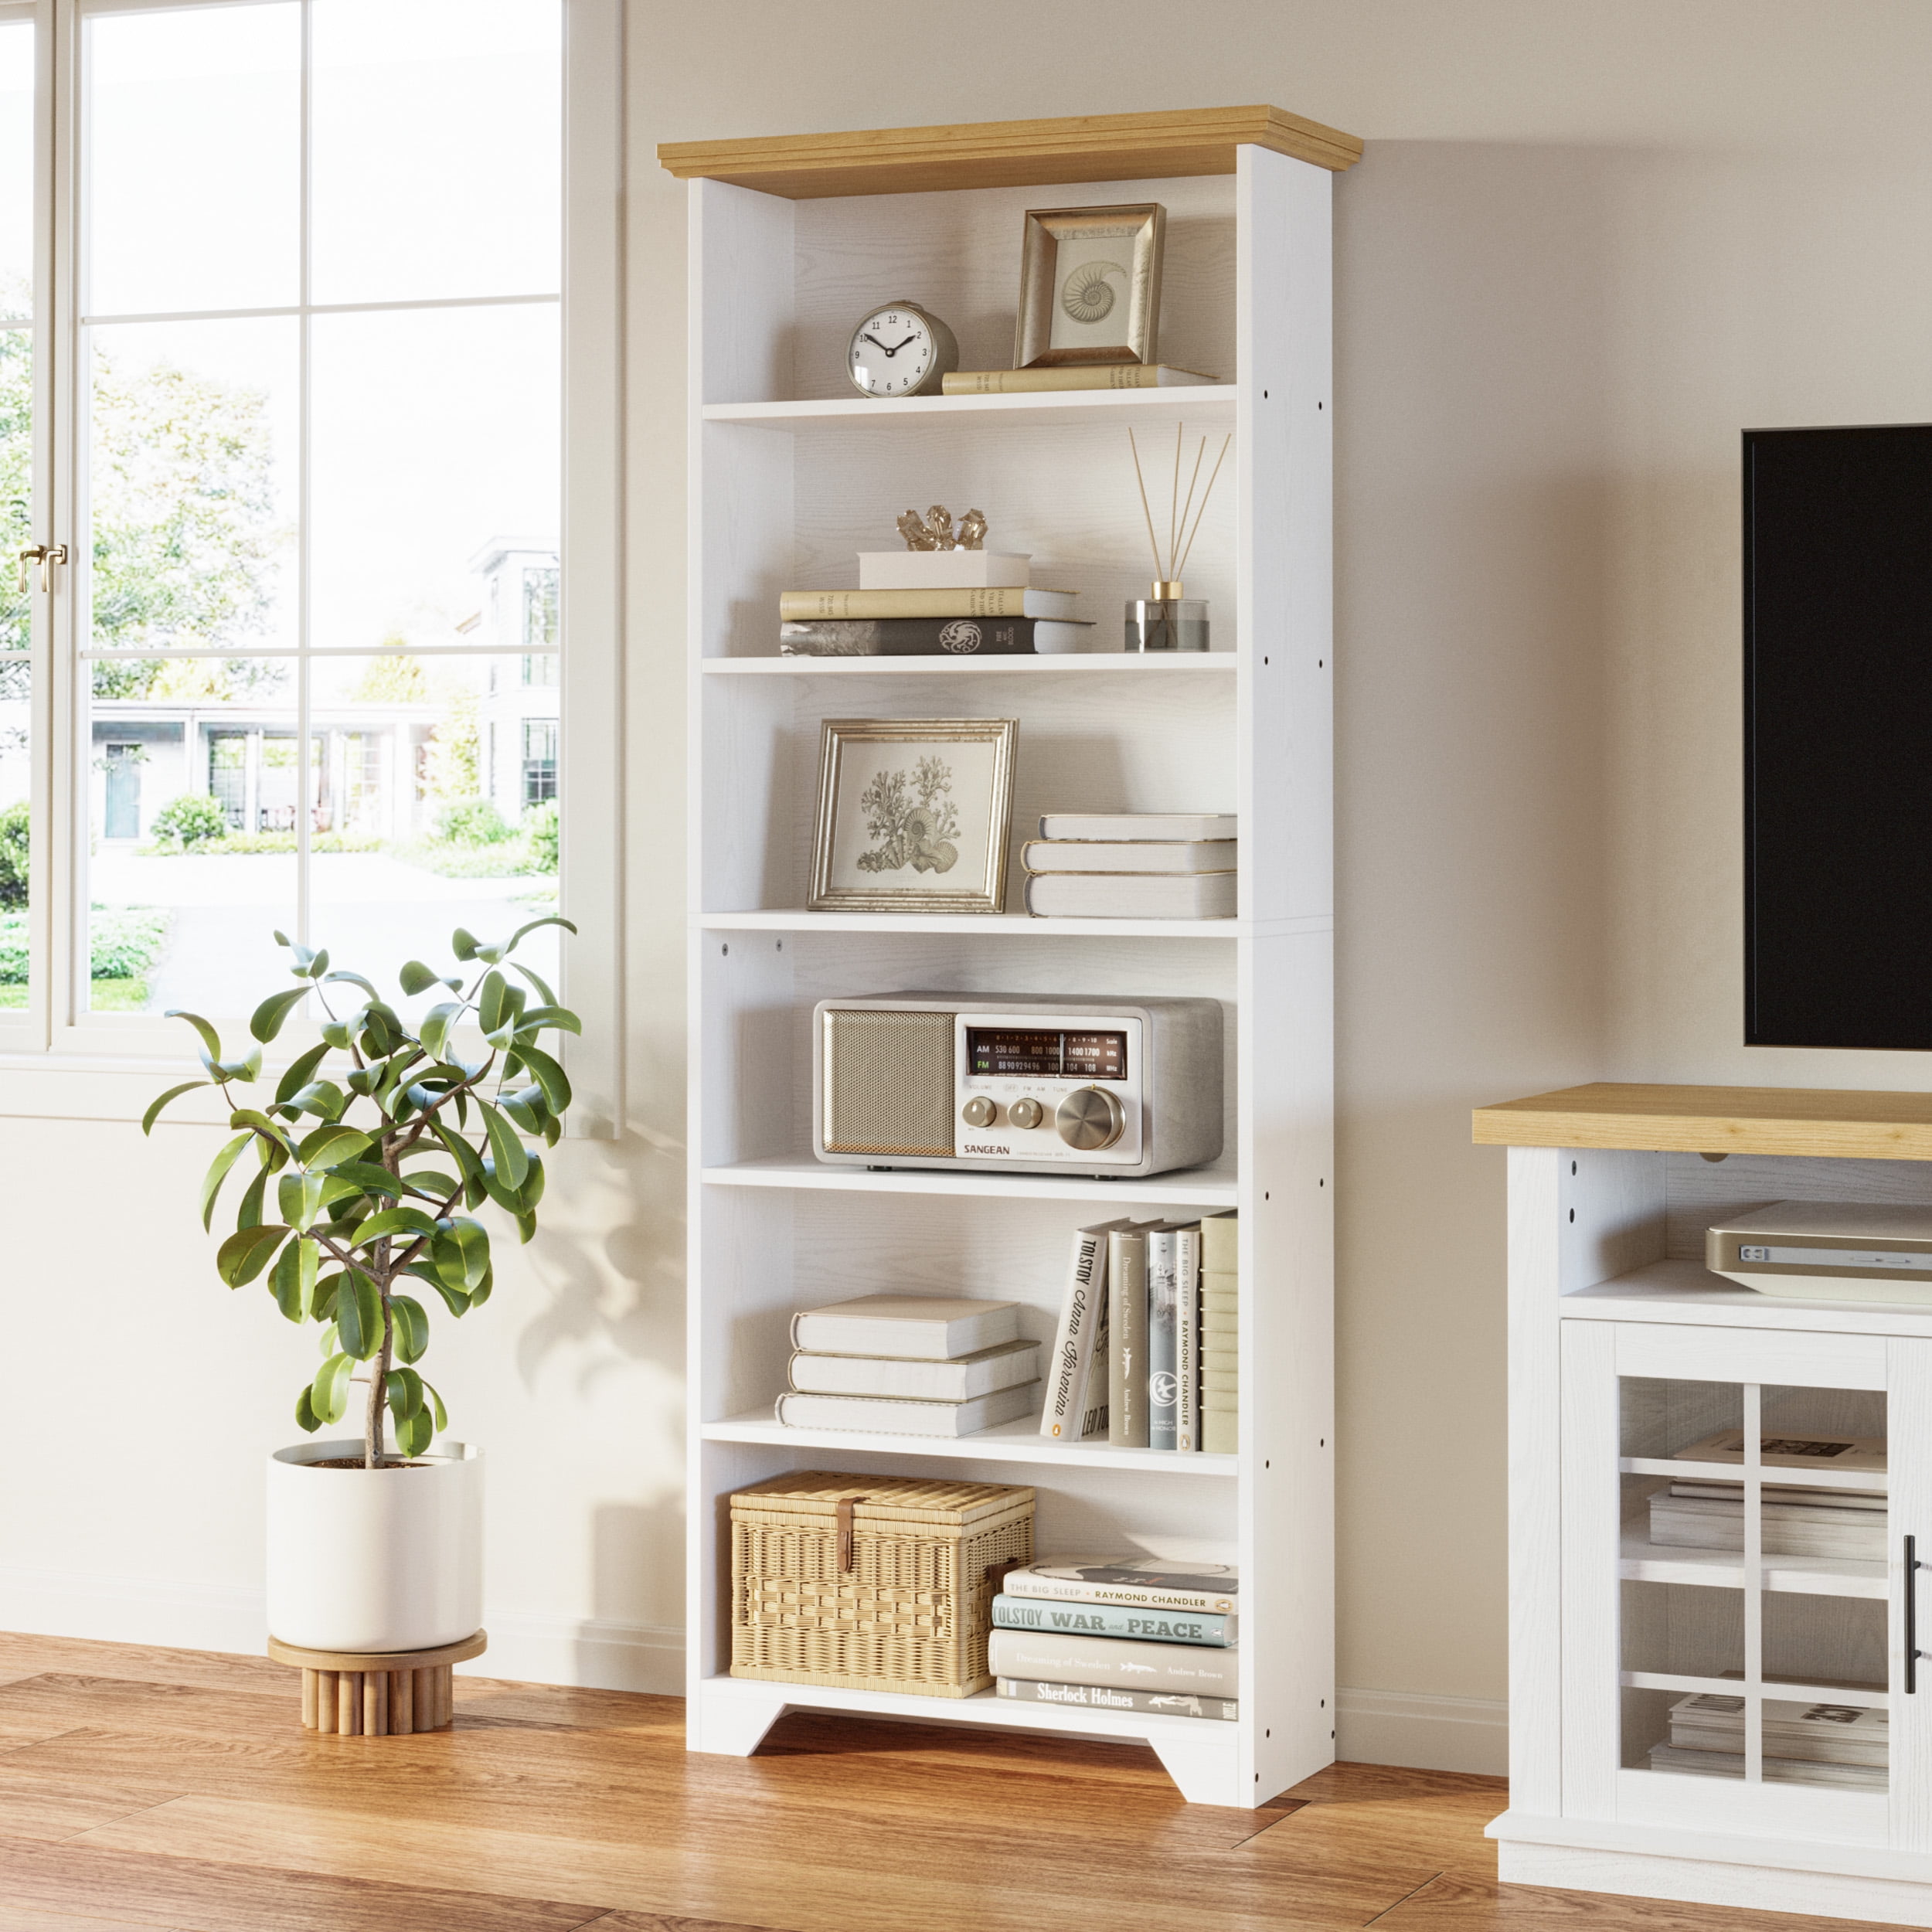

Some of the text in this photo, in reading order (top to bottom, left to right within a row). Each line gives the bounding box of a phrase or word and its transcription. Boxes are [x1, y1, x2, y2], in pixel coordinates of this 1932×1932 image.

[889, 315, 897, 324] 12
[995, 1046, 1006, 1054] 530
[1009, 1046, 1020, 1054] 600
[1031, 1046, 1043, 1055] 800
[1045, 1046, 1060, 1055] 1000
[1068, 1047, 1083, 1056] 1400
[1084, 1047, 1100, 1056] 1700
[998, 1061, 1006, 1070] 88
[1015, 1062, 1023, 1070] 92
[1023, 1062, 1031, 1070] 94
[1032, 1062, 1039, 1070] 96
[1084, 1063, 1097, 1072] 108
[964, 1145, 1010, 1155] SANGEAN
[1121, 1257, 1131, 1339] Dreaming of Sweden
[1055, 1240, 1097, 1417] TOLSTOY Anna Karenina
[1082, 1407, 1097, 1437] LEO
[1011, 1583, 1206, 1607] THE BIG SLEEP RAYMOND CHANDLER
[993, 1606, 1043, 1627] TOLSTOY
[1050, 1611, 1106, 1631] WAR
[1127, 1618, 1202, 1639] PEACE
[1015, 1652, 1111, 1670] Dreaming of Sweden
[1167, 1665, 1223, 1679] Andrew Brown
[1037, 1683, 1134, 1708] Sherlock Holmes
